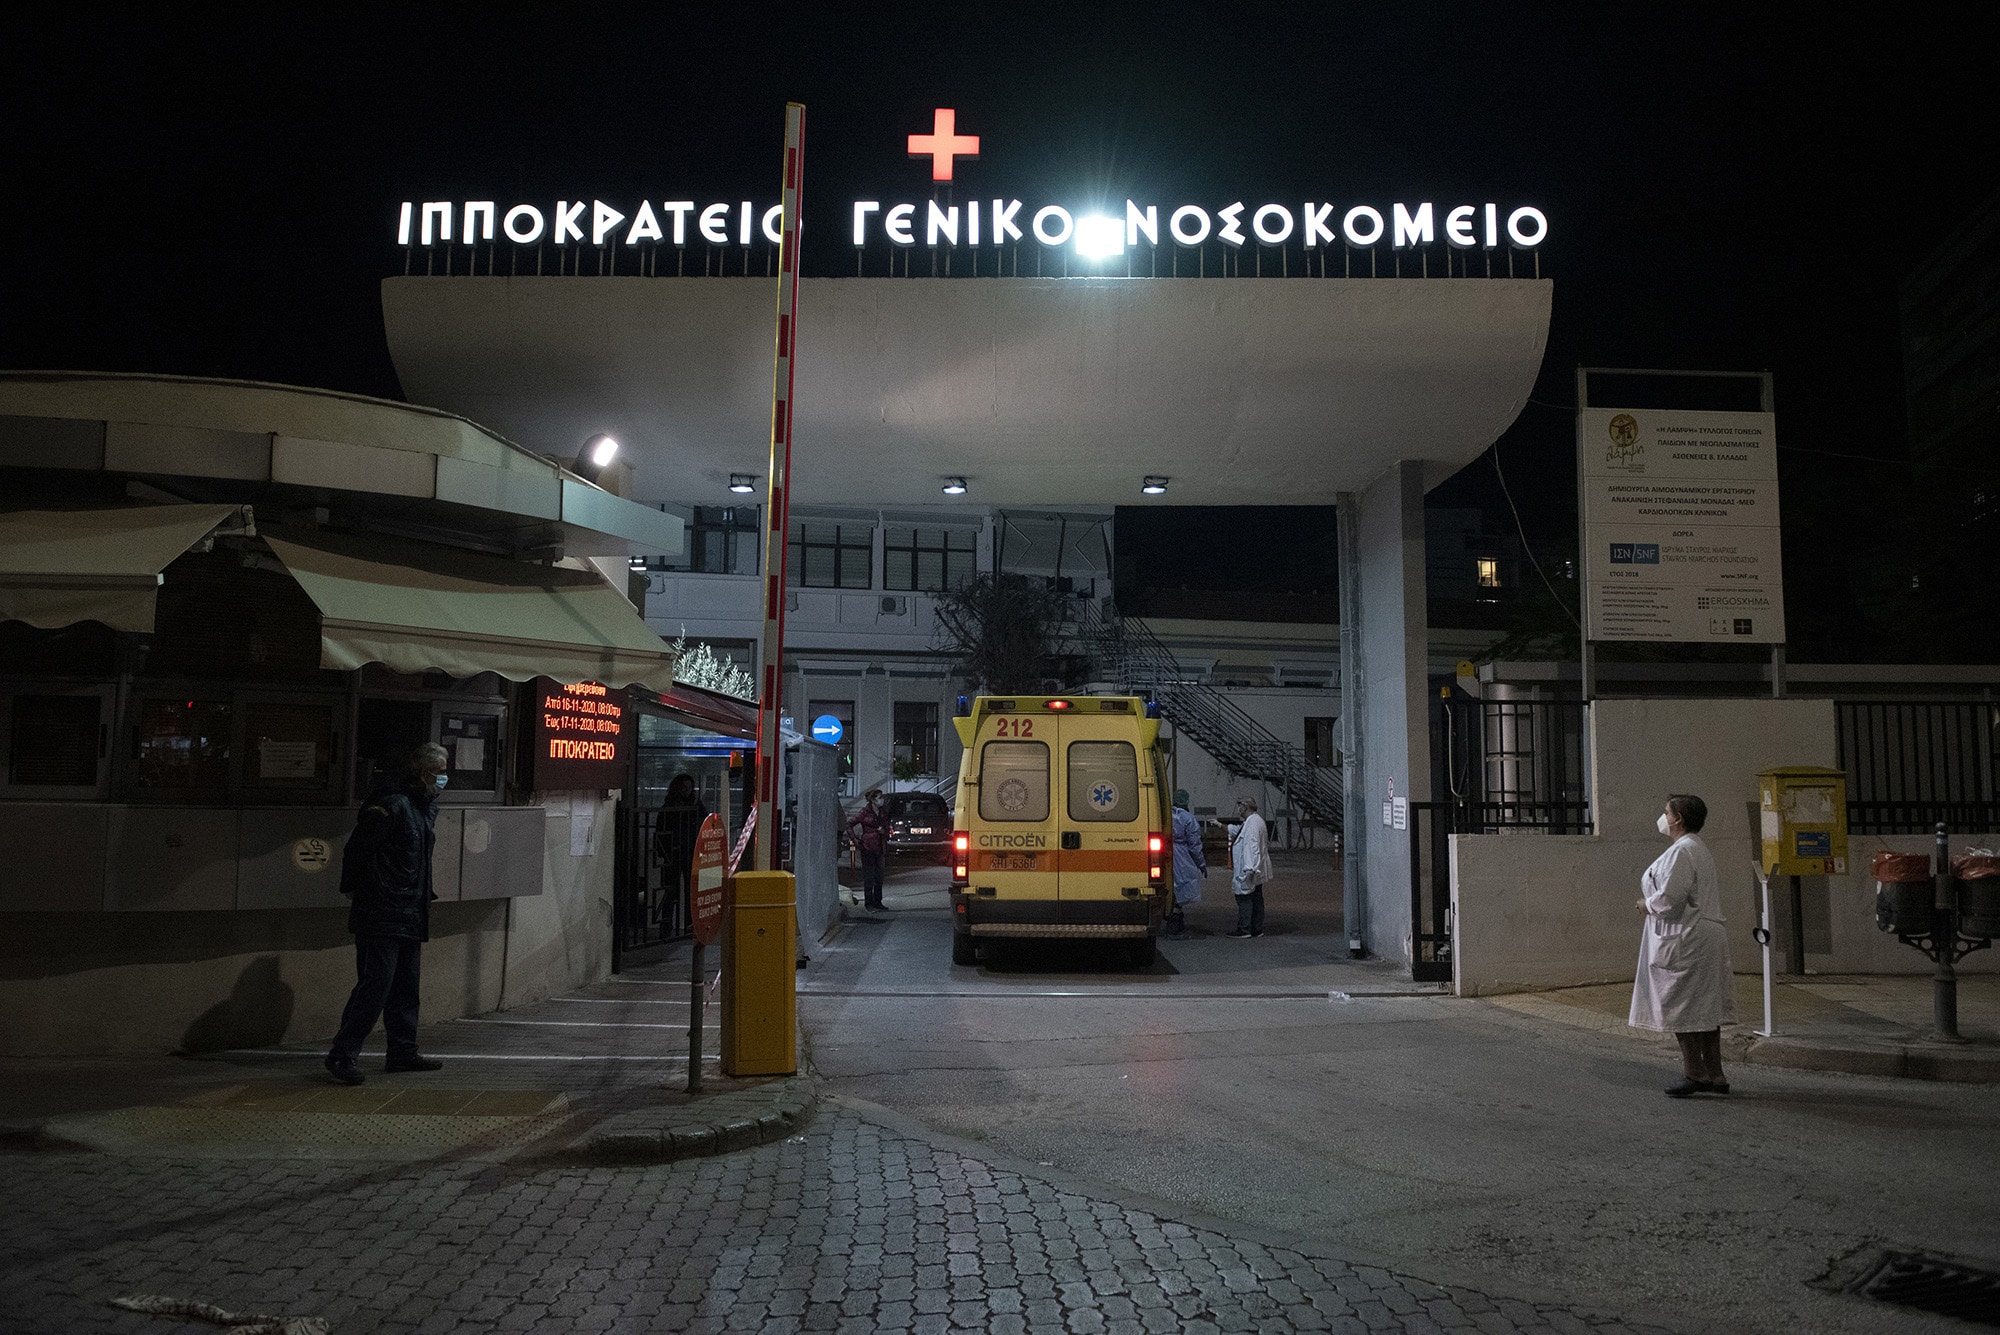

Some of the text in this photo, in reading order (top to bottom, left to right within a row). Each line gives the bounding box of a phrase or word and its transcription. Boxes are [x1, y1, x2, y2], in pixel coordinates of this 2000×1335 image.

[397, 199, 1549, 248] ΙΠΠΟΚΡΑΤΕΙΟ ΓΕΝΙΚΟ ΝΟΣΟΚΟΜΕΙΟ
[1710, 596, 1770, 606] ERGOSXHMA
[544, 696, 562, 710] Από
[544, 714, 560, 731] Έως
[996, 718, 1033, 737] 212
[550, 739, 615, 760] ΙΠΠΟΚΡΑΤΕΙΟ
[979, 832, 1046, 848] CITROËN
